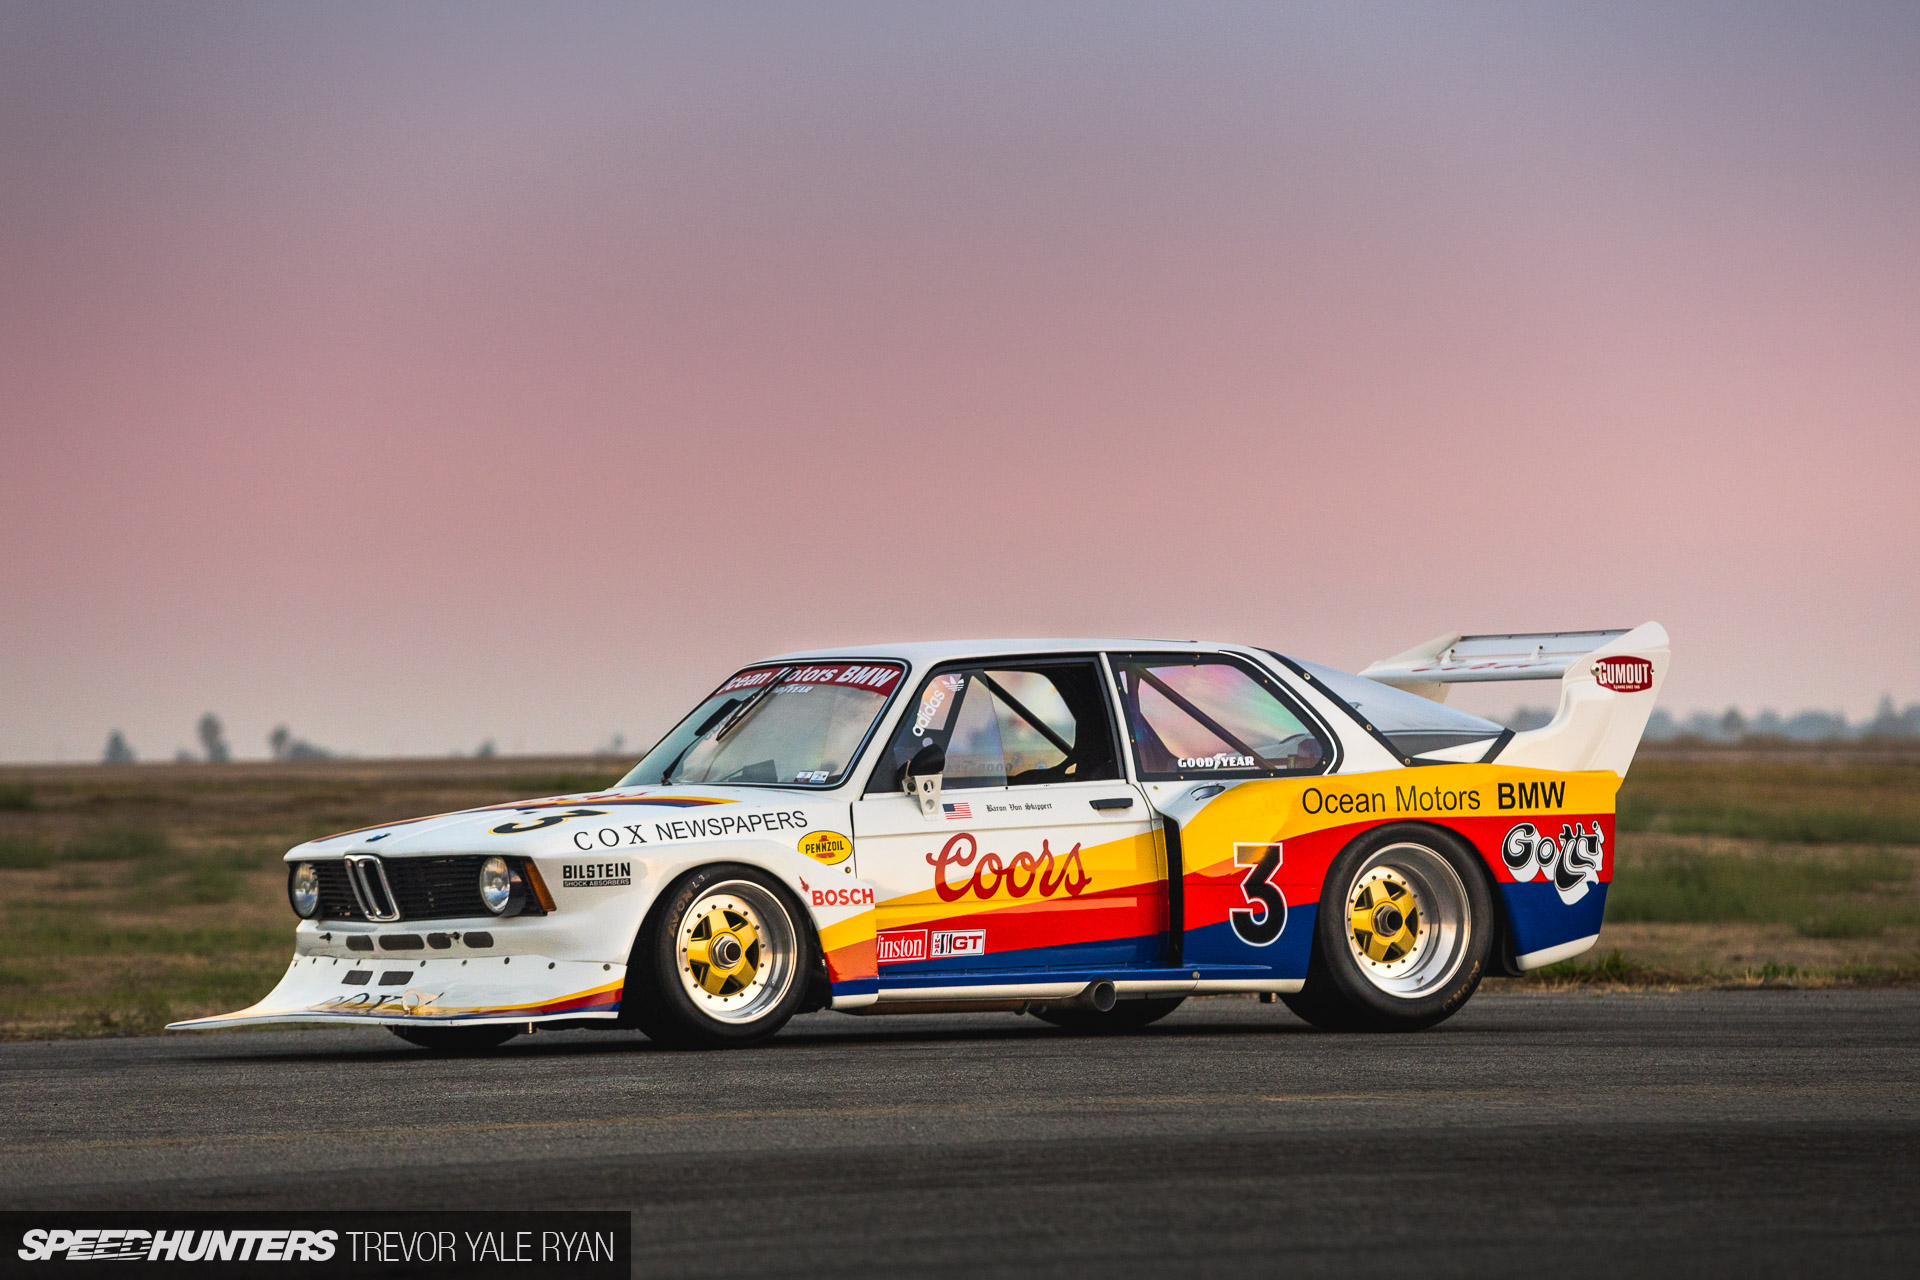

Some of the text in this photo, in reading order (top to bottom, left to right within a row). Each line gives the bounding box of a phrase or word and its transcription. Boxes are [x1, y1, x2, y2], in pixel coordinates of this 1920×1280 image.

[836, 665, 900, 687] BMW
[1599, 661, 1649, 684] GUMOUT
[912, 689, 945, 737] adidas
[1302, 781, 1566, 814] Ocean Motors BMW
[655, 810, 808, 841] NEWSPAPERS
[805, 840, 845, 854] PENNZOIL
[1501, 820, 1604, 898] Gotti
[563, 862, 631, 879] BILSTEIN
[926, 832, 1092, 902] Coors
[589, 878, 630, 886] ABSORBERS
[1229, 842, 1288, 947] 3
[812, 888, 874, 906] BOSCH
[668, 889, 693, 938] AVON
[953, 935, 982, 950] GT
